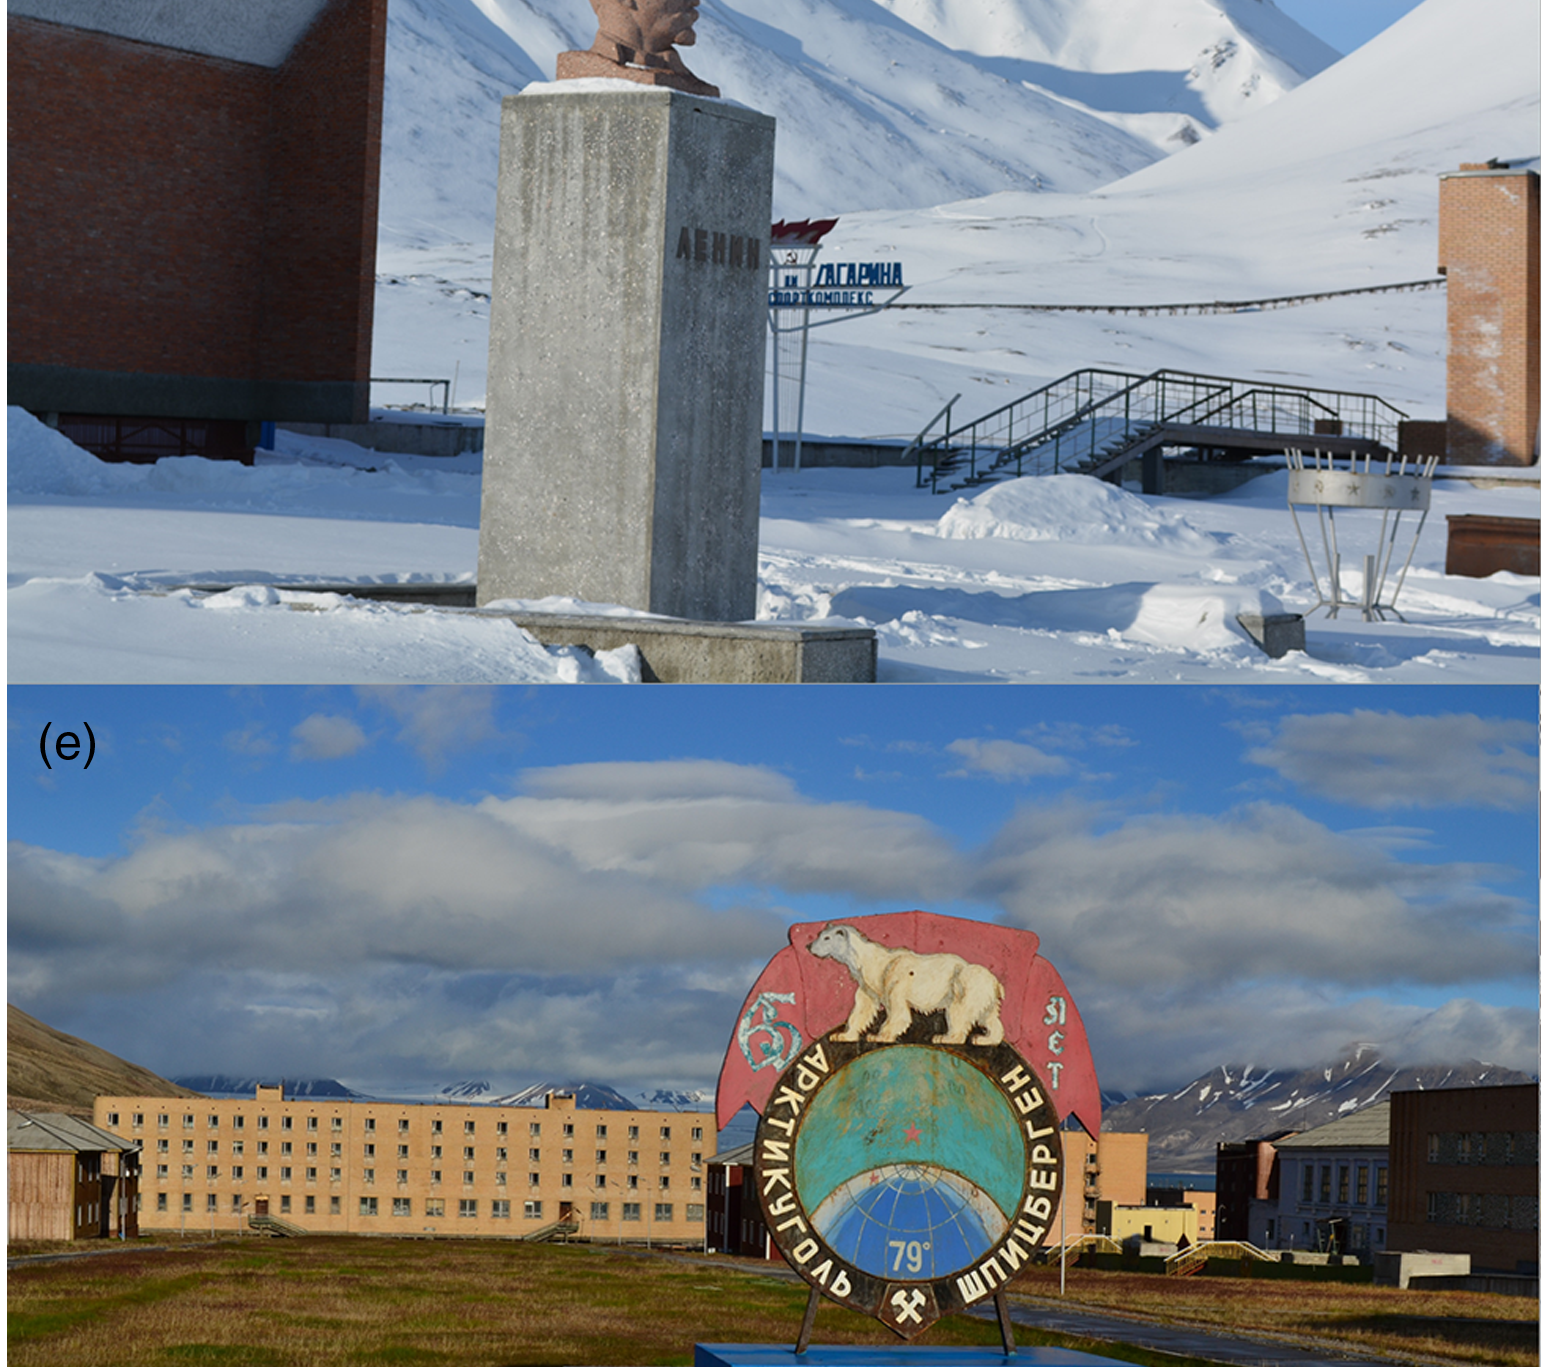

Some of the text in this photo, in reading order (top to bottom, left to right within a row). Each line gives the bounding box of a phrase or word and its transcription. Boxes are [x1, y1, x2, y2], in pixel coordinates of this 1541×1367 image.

[675, 226, 761, 270] ЛЕНИН
[814, 262, 903, 287] ГАГАРИНА
[761, 1043, 852, 1299] АРКТИКУГОЛЬ
[955, 1064, 1057, 1304] ШПИЦБЕРГЕН
